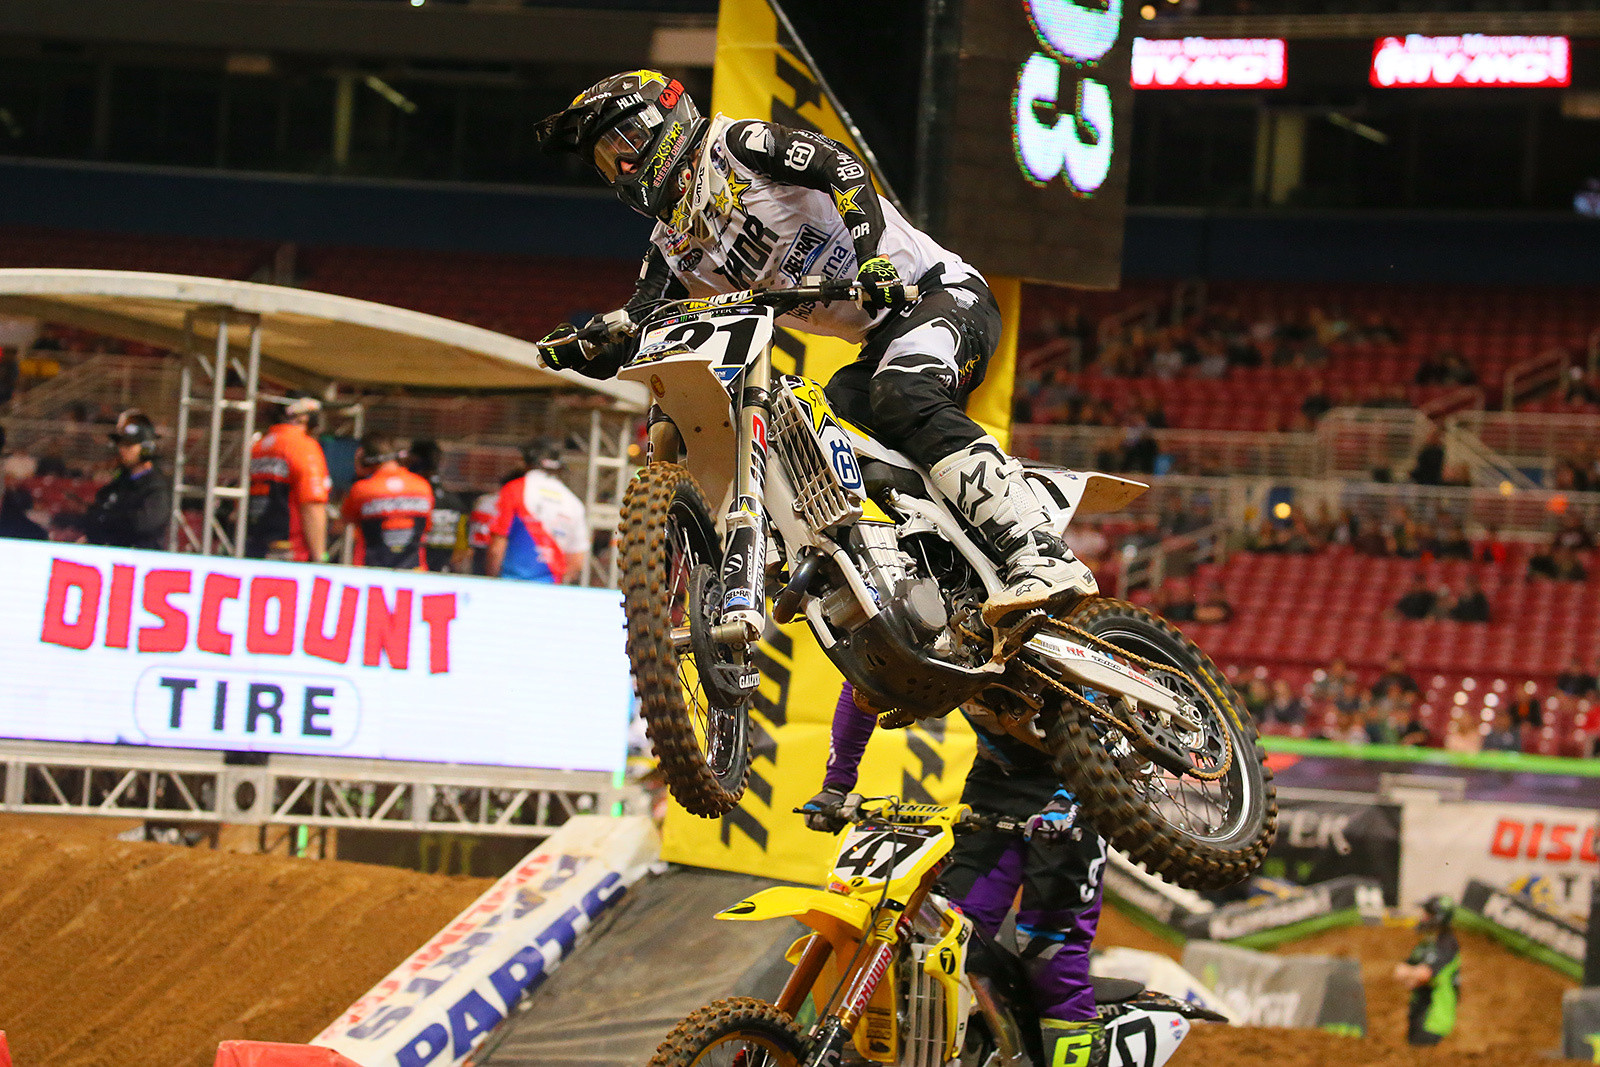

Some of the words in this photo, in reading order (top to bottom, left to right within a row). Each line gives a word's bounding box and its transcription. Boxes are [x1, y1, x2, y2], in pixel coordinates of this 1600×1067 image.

[653, 155, 674, 188] ENERGY
[670, 134, 687, 156] DRINK
[663, 317, 760, 366] 21
[40, 558, 458, 674] DISCOUNT
[160, 677, 335, 737] TIRE
[835, 831, 927, 879] 47
[396, 871, 628, 1067] PARTS
[852, 945, 894, 1017] SHOWA
